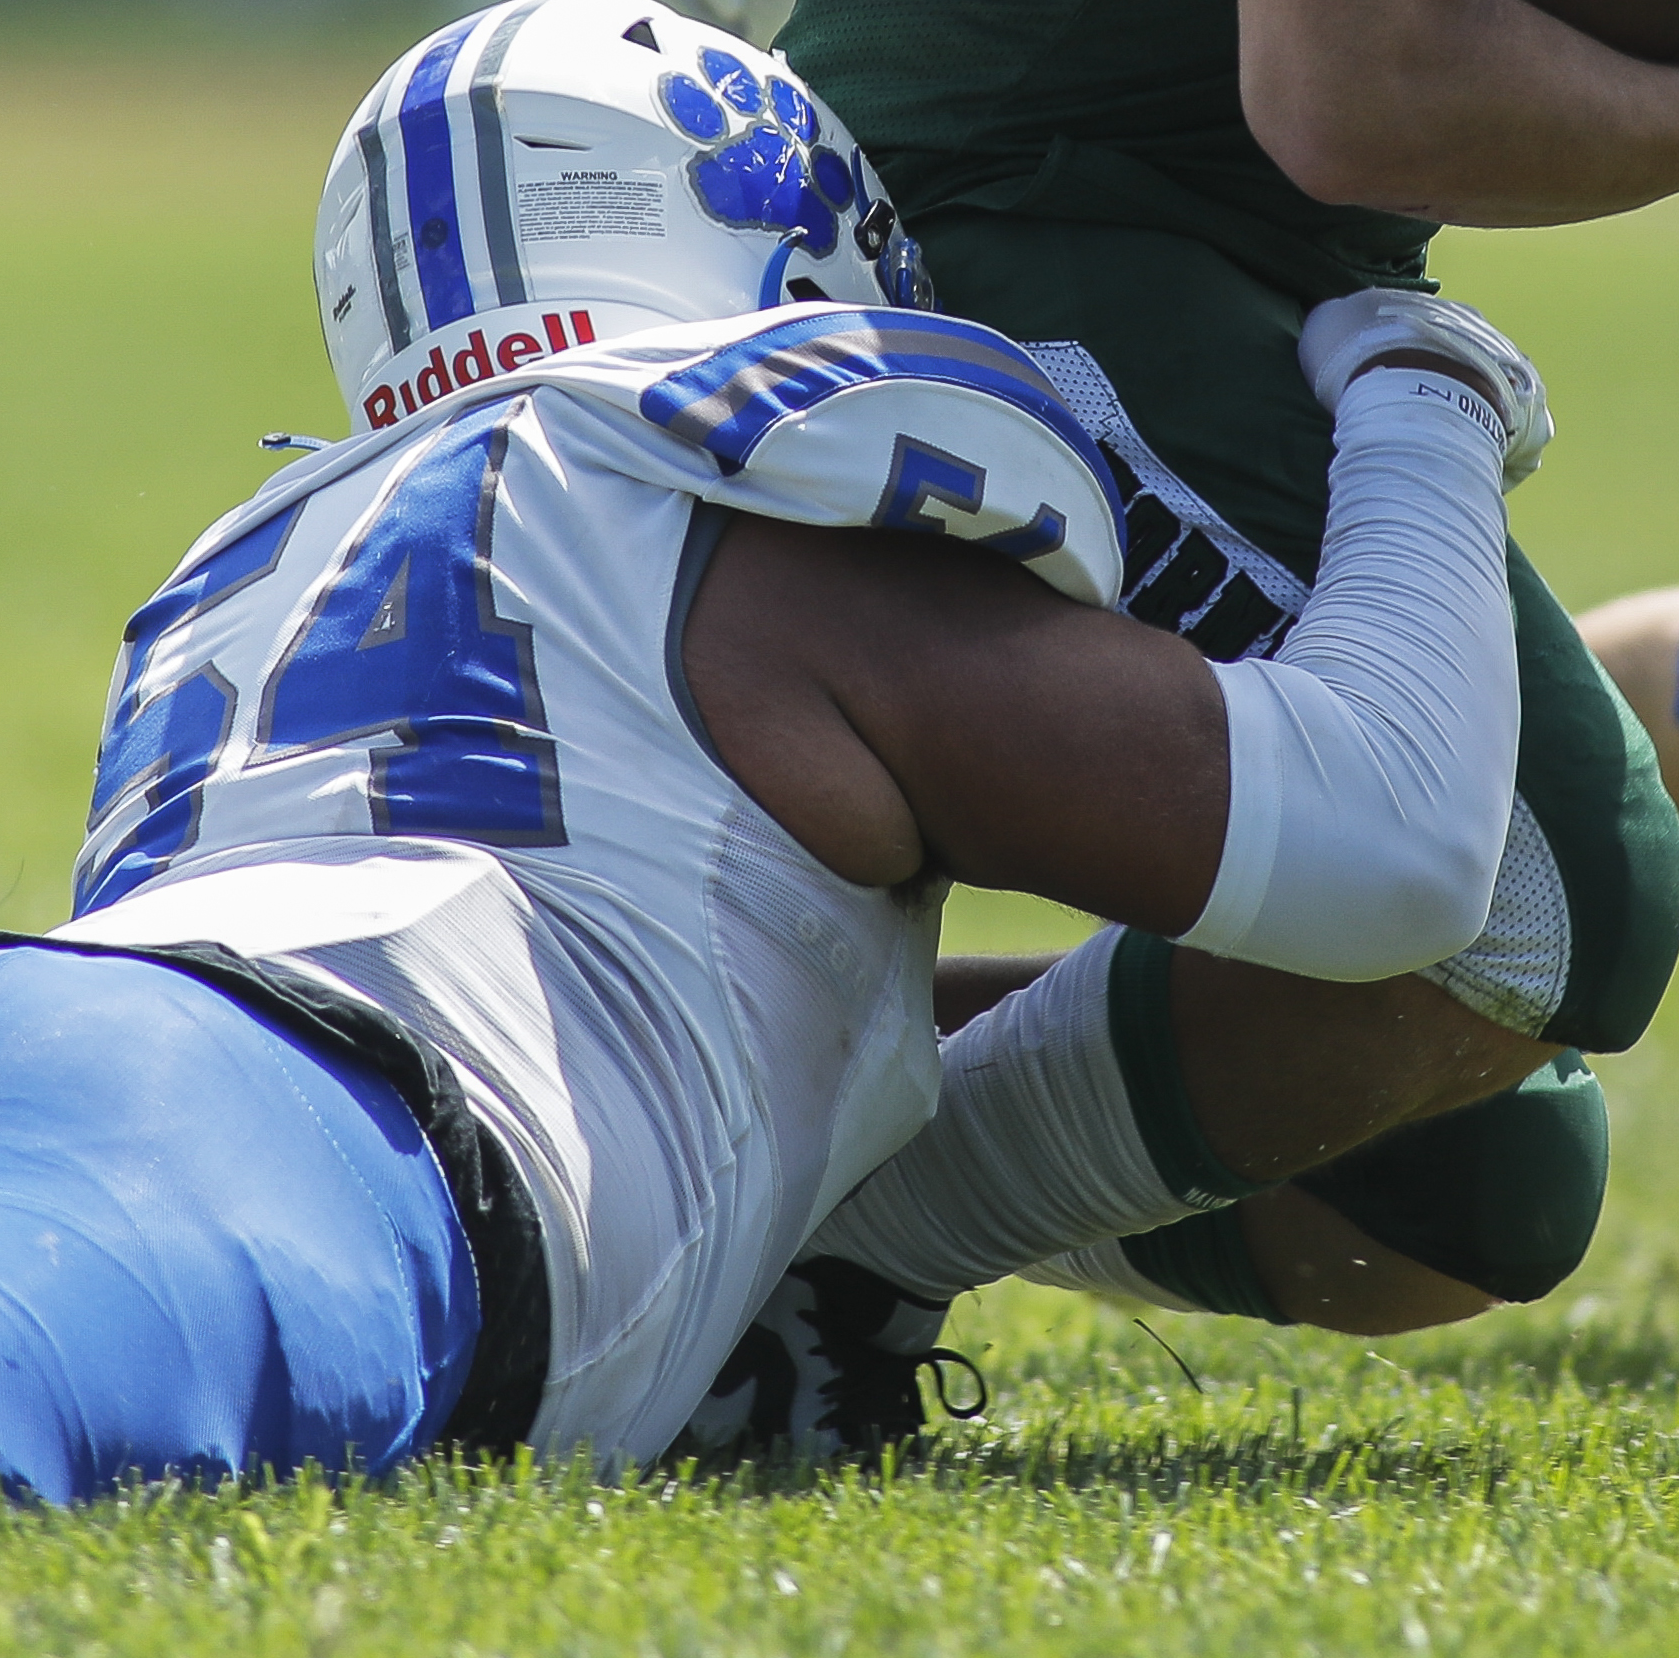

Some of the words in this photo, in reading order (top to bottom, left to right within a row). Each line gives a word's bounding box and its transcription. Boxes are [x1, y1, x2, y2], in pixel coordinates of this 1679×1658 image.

[561, 171, 618, 181] WARNING
[363, 310, 595, 430] Riddell
[72, 392, 570, 922] 54
